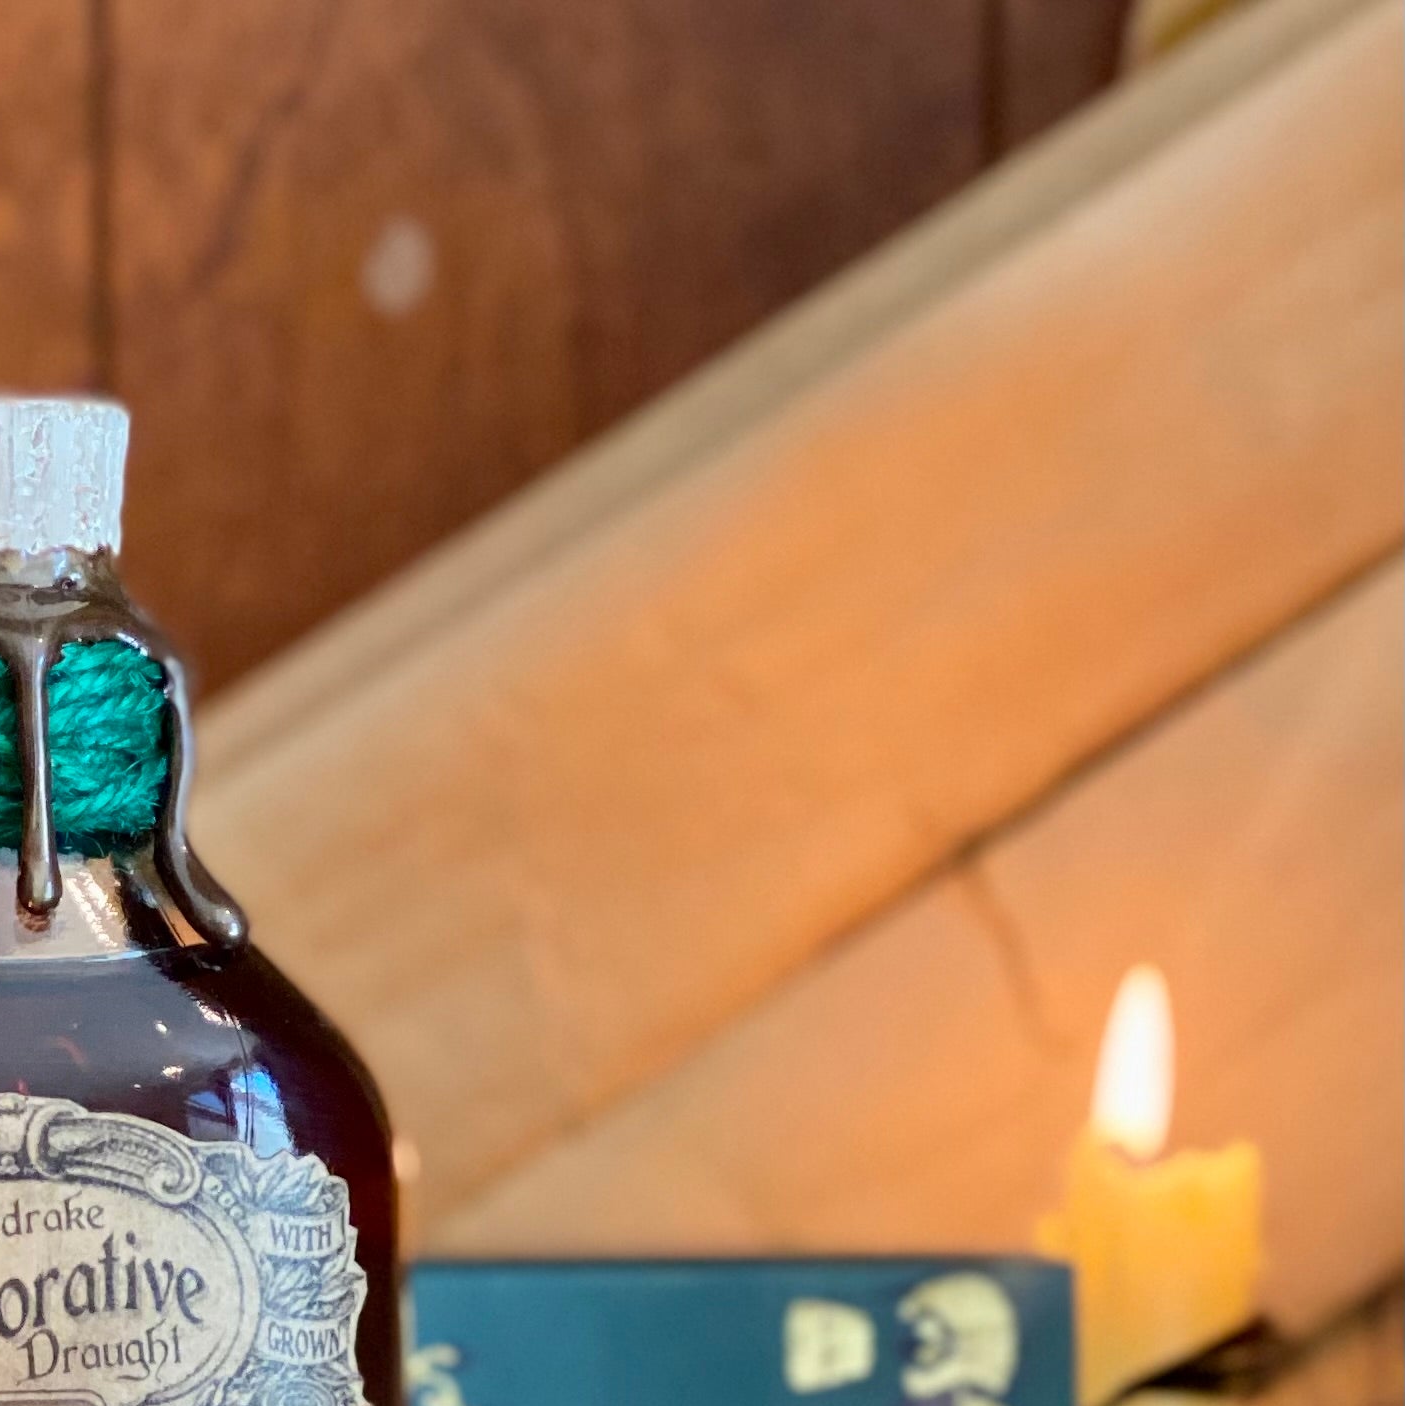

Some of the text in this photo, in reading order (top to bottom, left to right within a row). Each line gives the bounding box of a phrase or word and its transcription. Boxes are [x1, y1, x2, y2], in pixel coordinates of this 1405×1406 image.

[271, 1217, 332, 1250] WITH
[16, 1318, 182, 1386] Draught
[267, 1320, 342, 1357] GROWN
